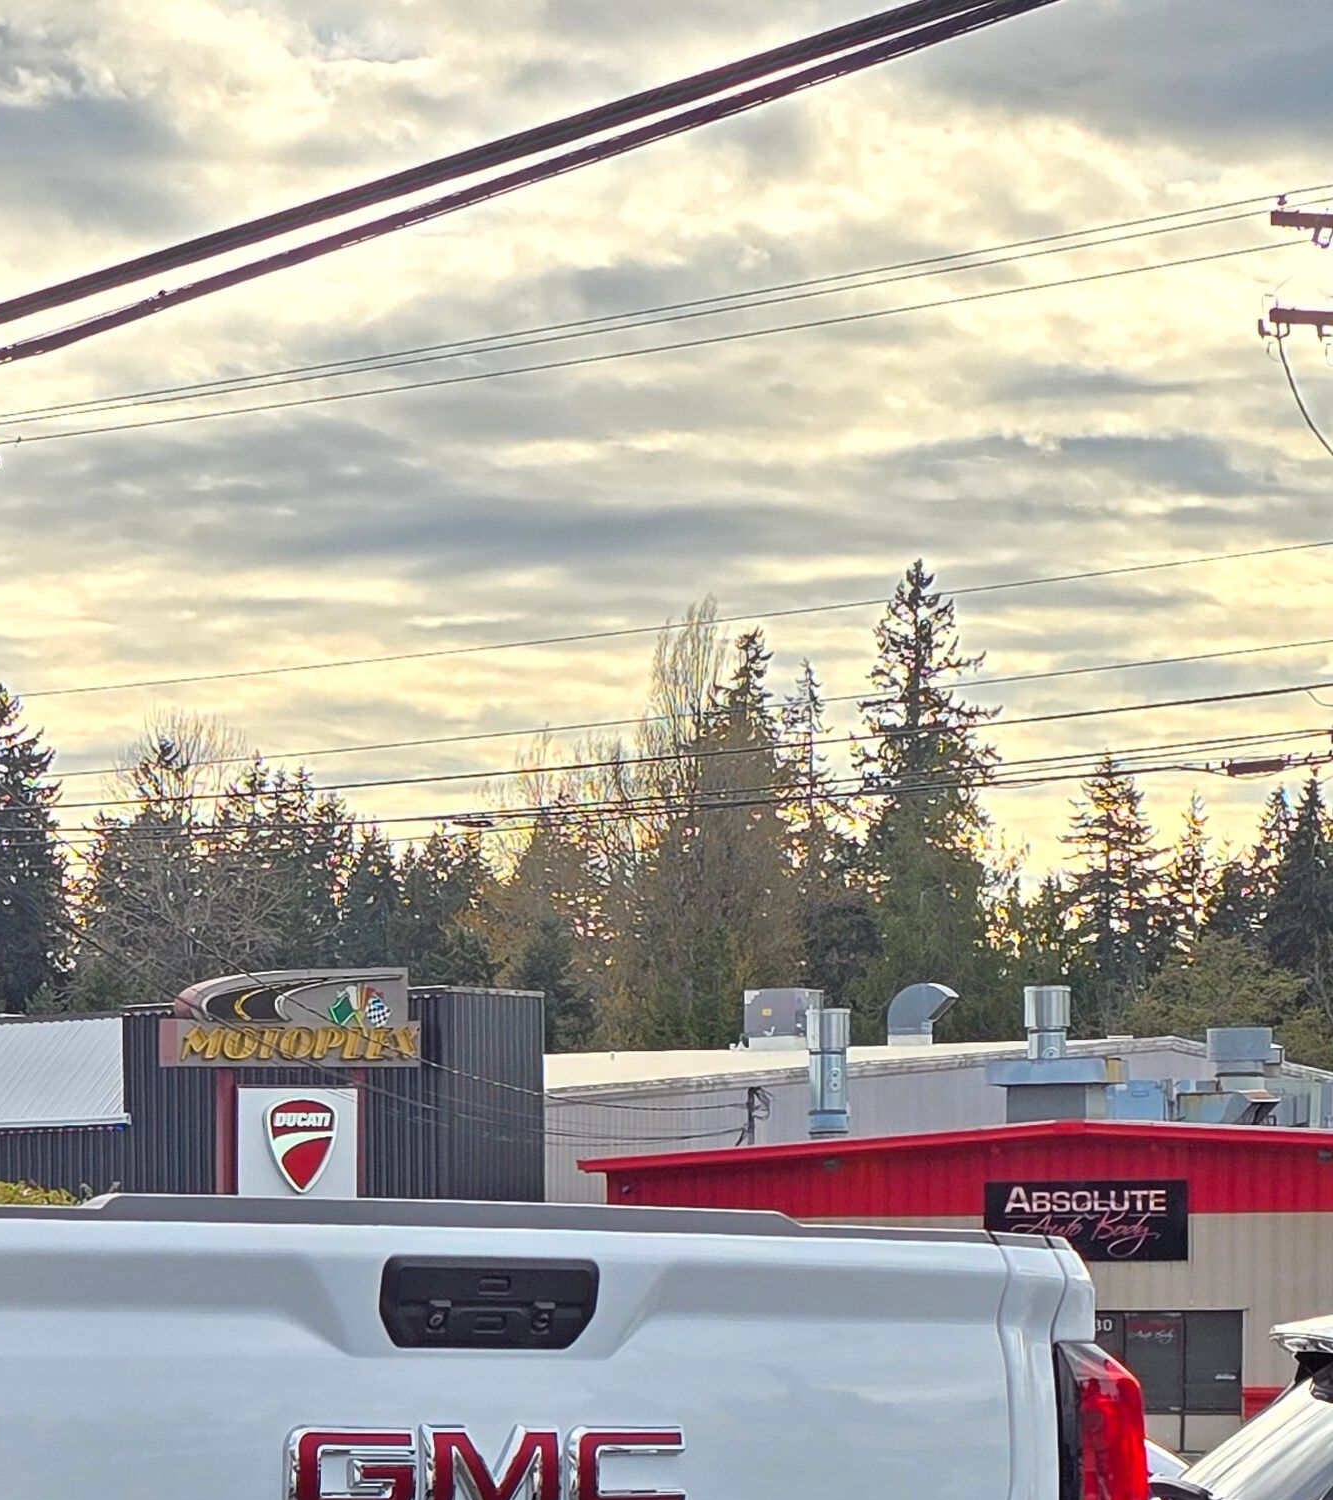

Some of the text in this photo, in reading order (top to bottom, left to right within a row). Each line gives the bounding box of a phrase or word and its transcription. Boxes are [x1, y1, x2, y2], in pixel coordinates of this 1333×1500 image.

[182, 1026, 421, 1062] MOTOPLEX
[273, 1112, 331, 1128] DUCATI
[1010, 1209, 1161, 1258] Auto Body
